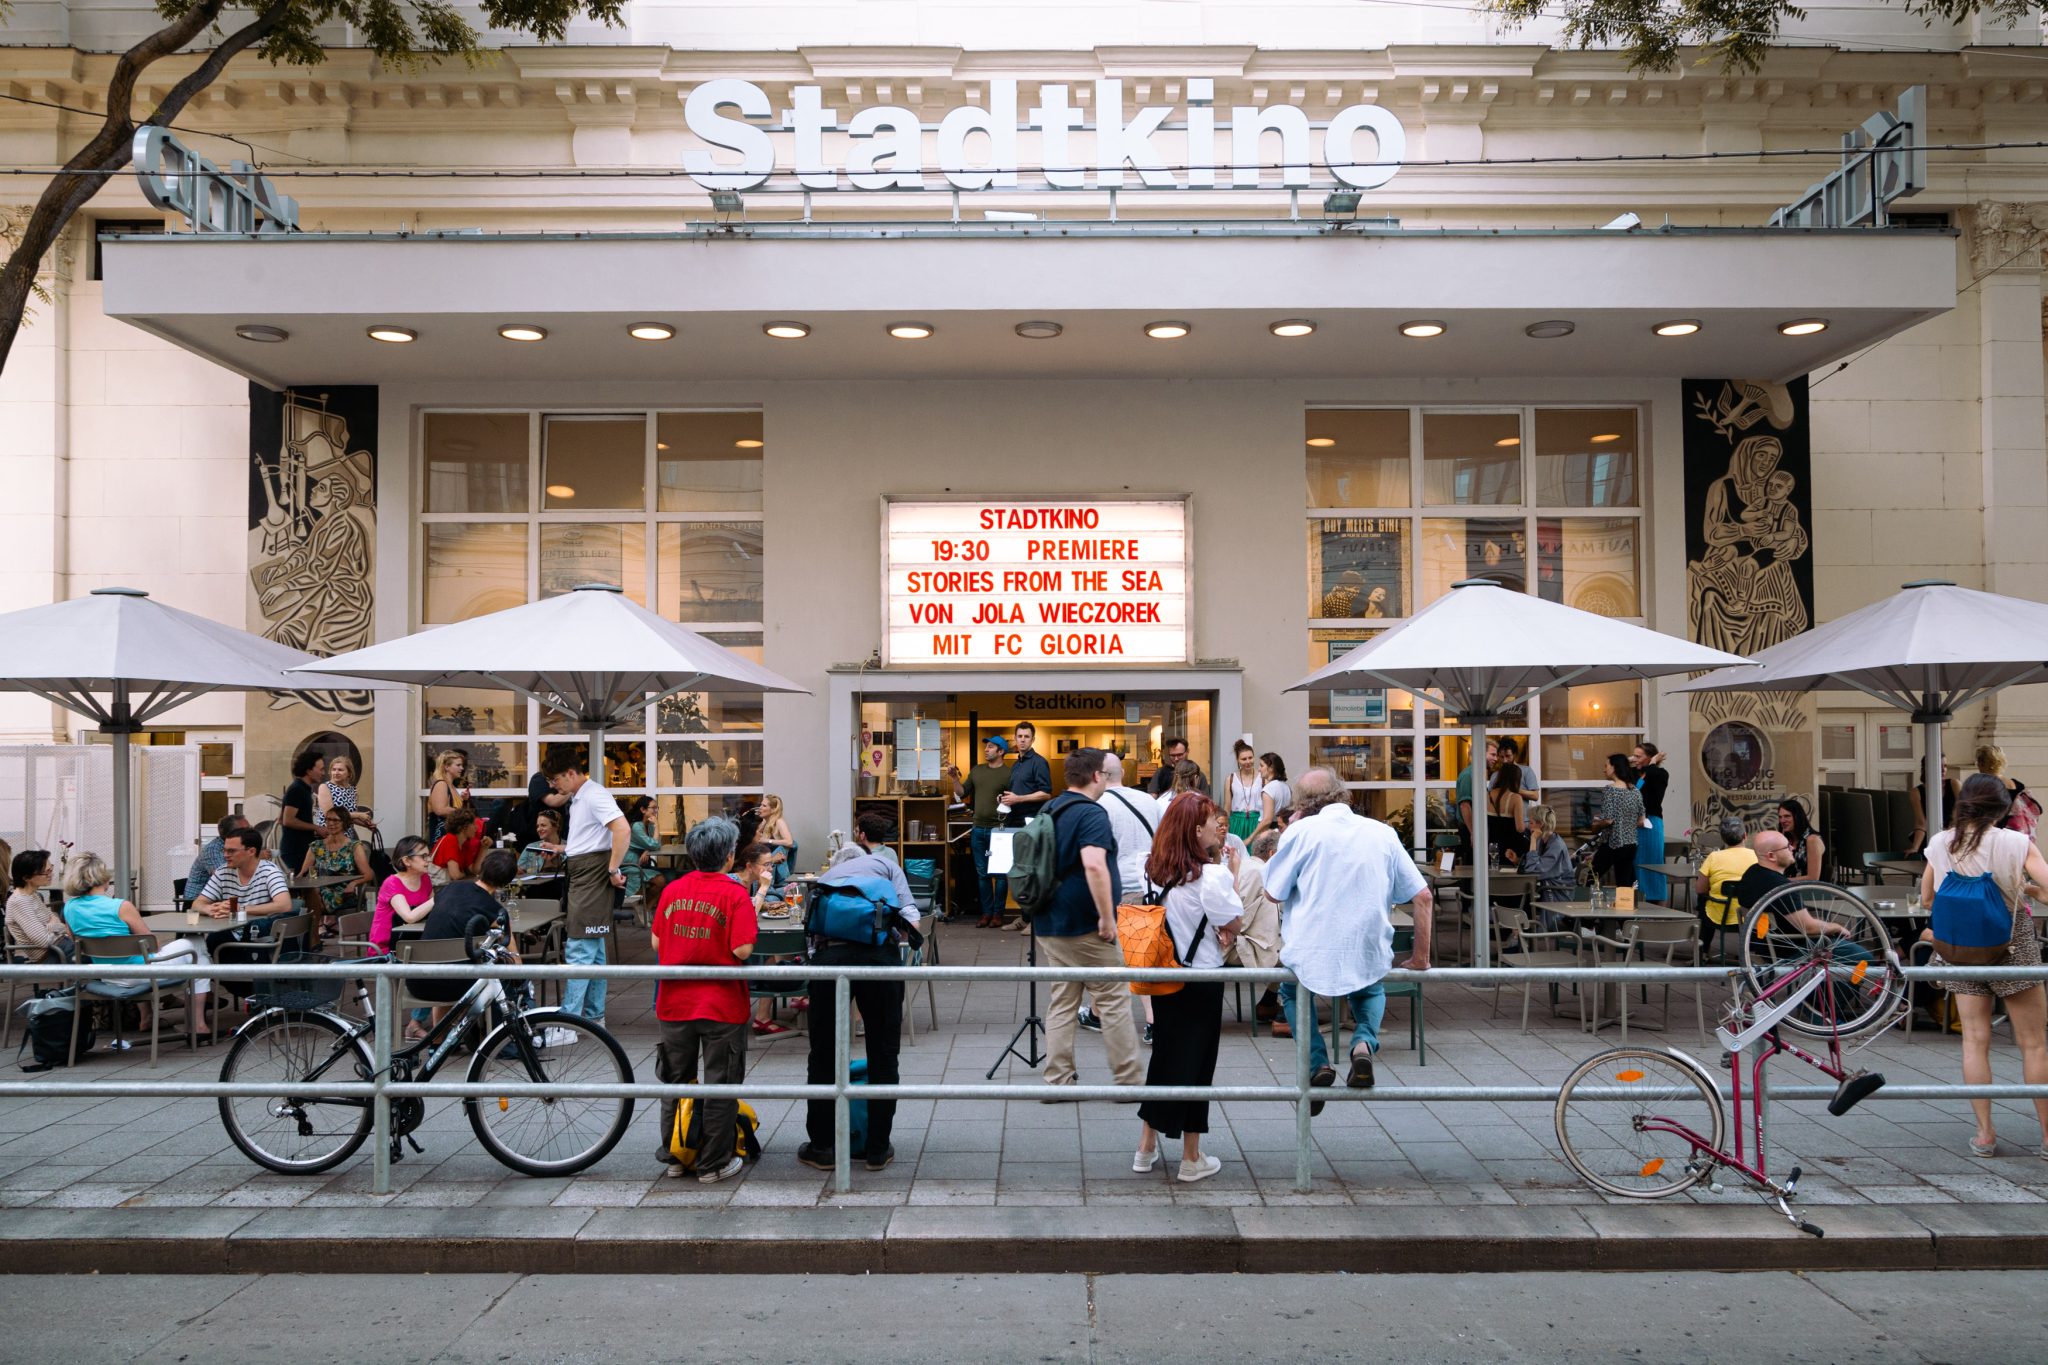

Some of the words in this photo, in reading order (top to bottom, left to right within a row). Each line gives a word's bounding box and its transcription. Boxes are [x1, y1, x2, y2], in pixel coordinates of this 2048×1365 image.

[682, 79, 1406, 190] Stadtkino
[724, 522, 763, 530] SAPIEN
[980, 508, 1099, 530] STADTKINO
[1324, 518, 1341, 533] BOY
[1346, 518, 1373, 533] MEETS
[1378, 518, 1399, 533] GIRL
[580, 550, 610, 558] SLEEP
[932, 540, 989, 561] 19:30
[1028, 540, 1138, 560] PREMIERE
[908, 571, 994, 593] STORIES
[1004, 571, 1062, 592] FROM
[1071, 571, 1107, 591] THE
[1122, 570, 1163, 591] SEA
[909, 603, 953, 624] VON
[972, 603, 1025, 624] JOLA
[1039, 602, 1160, 623] WIECZOREK
[933, 634, 972, 655] MIT
[995, 634, 1022, 655] FC
[1040, 634, 1123, 655] GLORIA
[1014, 693, 1106, 710] Stadtkino
[1738, 781, 1775, 790] ADELE
[585, 925, 610, 934] RAUCH
[674, 923, 711, 939] DIVISION
